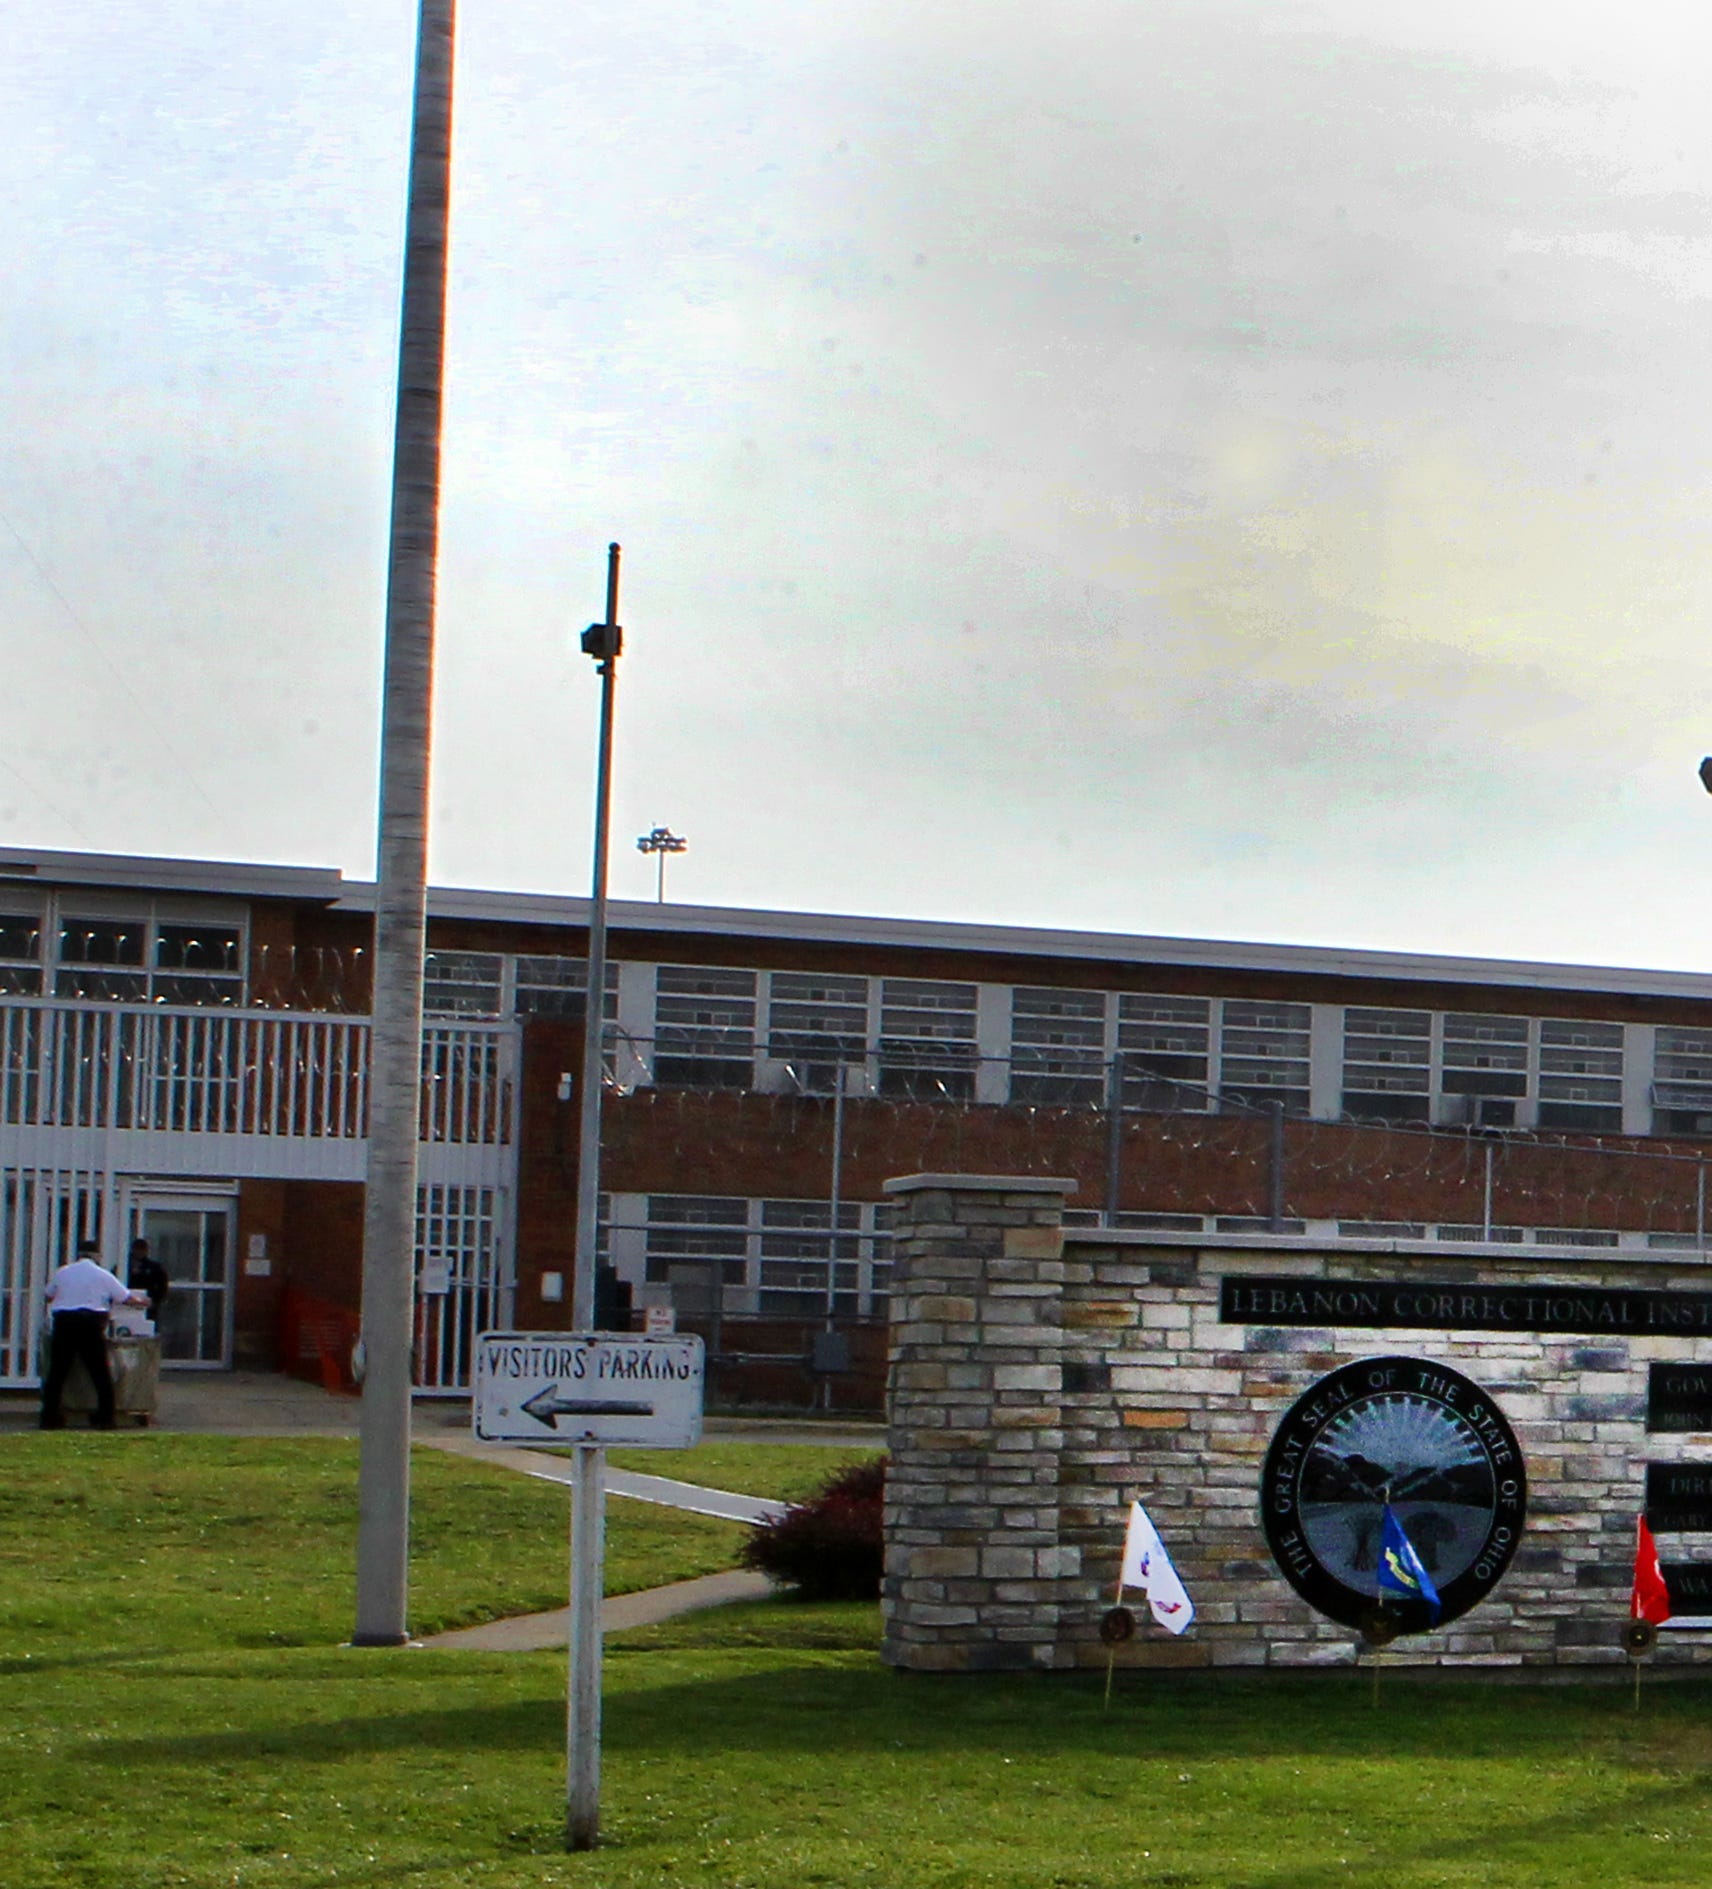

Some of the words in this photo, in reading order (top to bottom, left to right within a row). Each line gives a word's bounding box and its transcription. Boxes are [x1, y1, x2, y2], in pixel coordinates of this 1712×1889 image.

[1233, 1288, 1379, 1315] LEBANON
[1395, 1294, 1635, 1323] CORRECTIONAL
[487, 1346, 588, 1379] VISITORS
[598, 1348, 691, 1380] PARKING
[1368, 1368, 1397, 1388] OF
[1302, 1384, 1355, 1428] SEAL
[1418, 1371, 1461, 1402] THE
[1468, 1403, 1513, 1465] STATE
[1275, 1434, 1304, 1513] GREAT
[1500, 1479, 1518, 1511] OF
[1280, 1530, 1314, 1579] THE
[1474, 1526, 1512, 1580] OHIO
